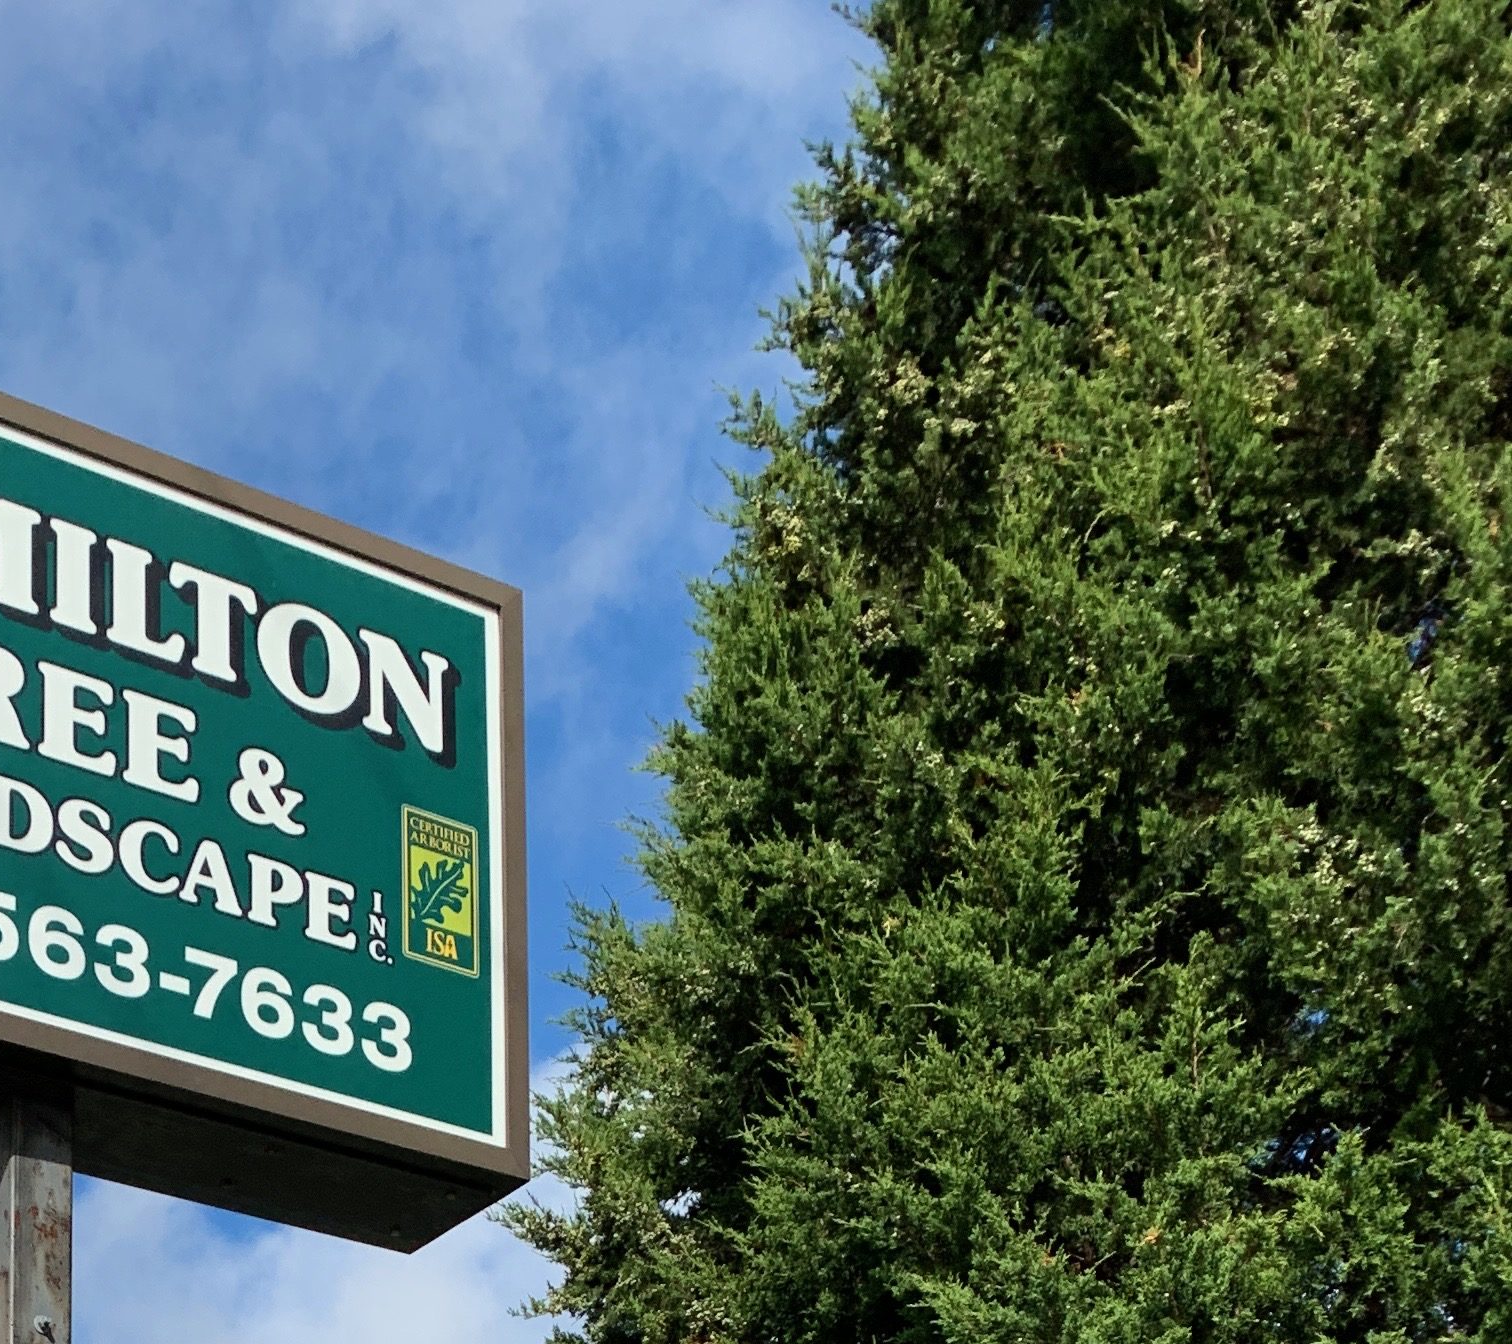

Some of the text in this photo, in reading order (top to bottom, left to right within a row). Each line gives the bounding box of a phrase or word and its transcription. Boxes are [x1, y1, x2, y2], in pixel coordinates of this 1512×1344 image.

[228, 747, 306, 836] &
[409, 816, 470, 846] CERTIFIED
[410, 831, 471, 859] ARBORIST
[369, 891, 394, 966] INC.
[425, 927, 458, 961] ISA
